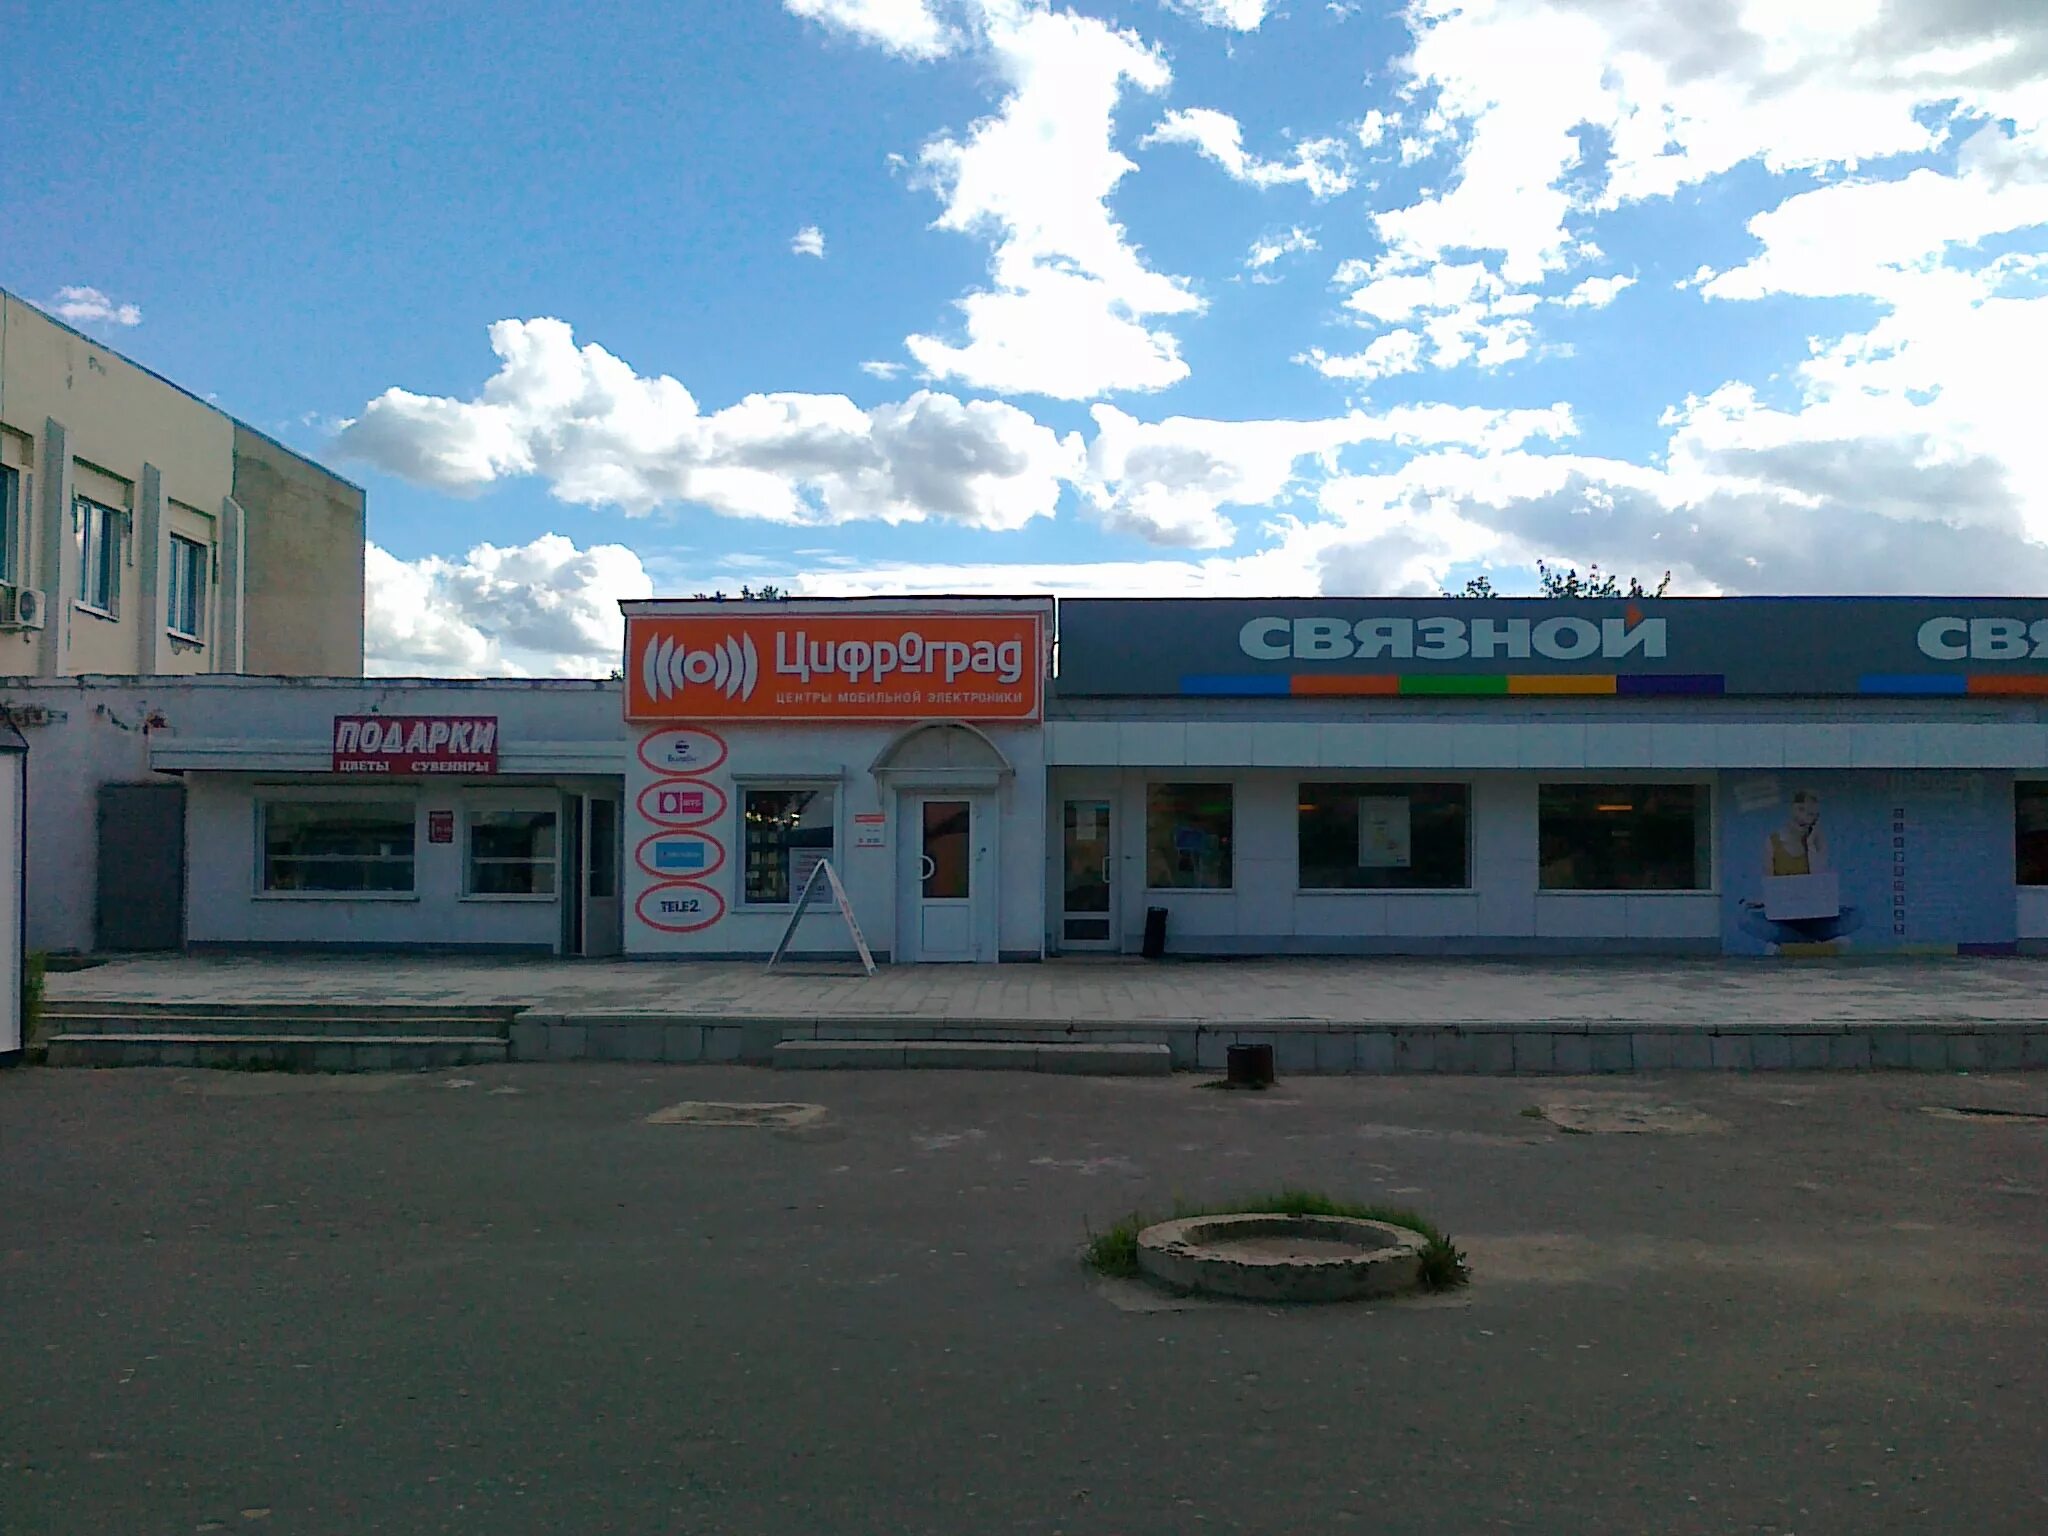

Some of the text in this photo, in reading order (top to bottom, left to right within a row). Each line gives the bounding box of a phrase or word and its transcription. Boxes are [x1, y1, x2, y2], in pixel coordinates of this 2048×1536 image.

[1239, 604, 1668, 661] СВЯЗНОЙ
[776, 690, 1022, 705] ЦЕНТРЫ МОБИЛЬНОЙ ЭЛЕКТРОНИКИ
[335, 719, 497, 754] ПОДАРКИ
[339, 760, 490, 773] ЦВЕТЫ СУВЕНИРЫ
[660, 899, 701, 913] TELE2
